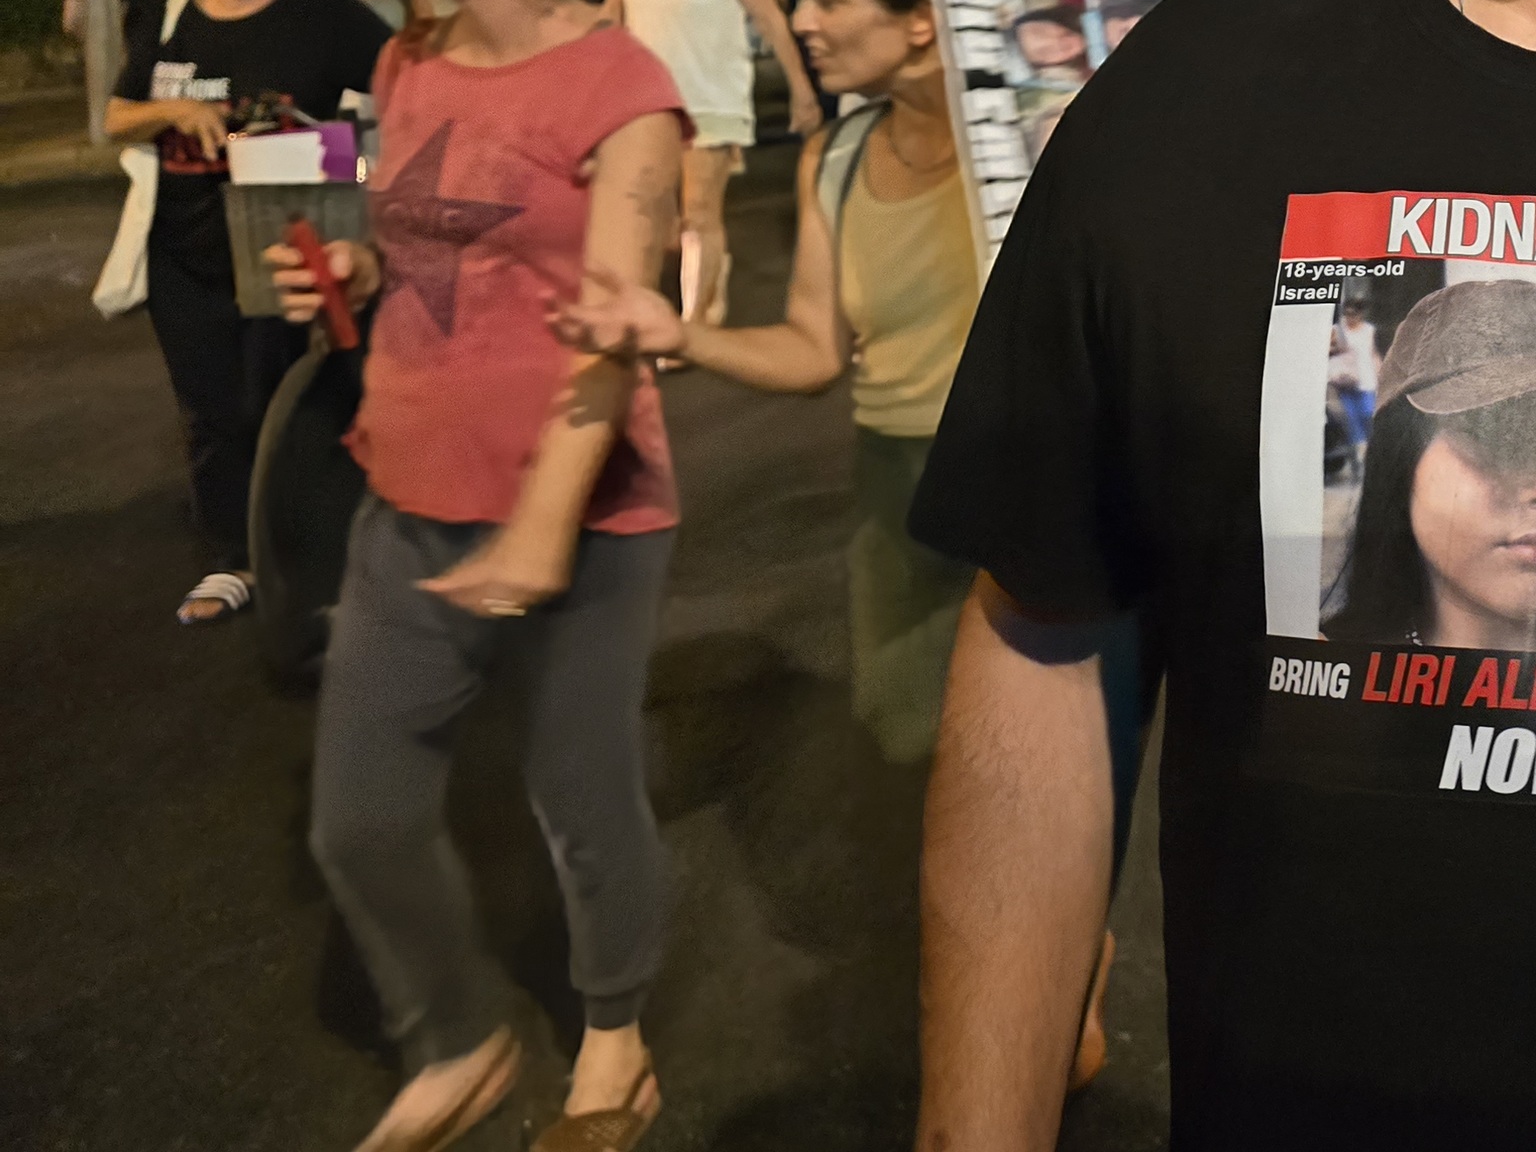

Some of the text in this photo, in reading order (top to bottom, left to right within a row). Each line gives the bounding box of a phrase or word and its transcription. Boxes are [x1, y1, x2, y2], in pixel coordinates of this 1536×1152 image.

[1282, 260, 1405, 281] 18-years-old
[1279, 283, 1341, 301] Israeli
[1269, 656, 1351, 699] BRING
[1361, 651, 1456, 706] LIRI
